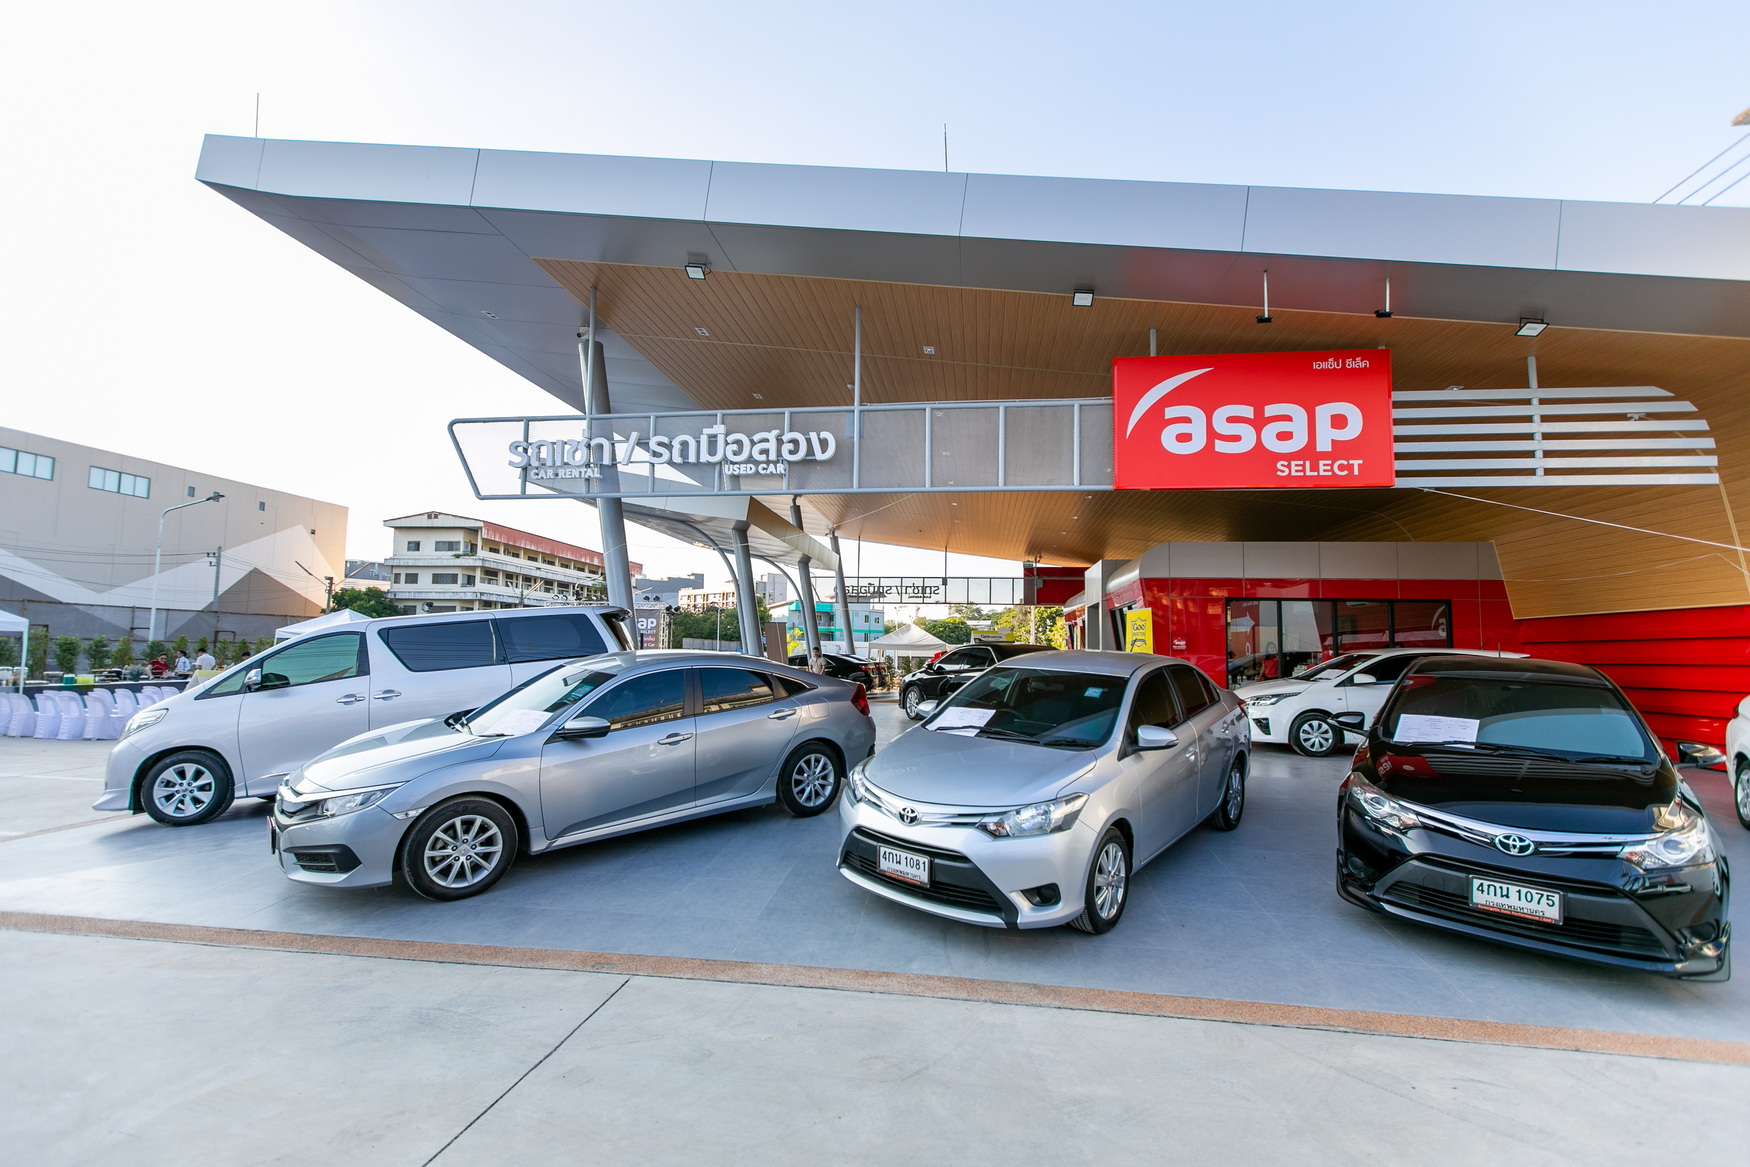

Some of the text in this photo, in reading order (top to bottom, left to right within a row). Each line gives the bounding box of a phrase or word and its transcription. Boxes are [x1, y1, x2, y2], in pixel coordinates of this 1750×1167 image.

[1161, 402, 1363, 455] asap
[508, 428, 612, 469] รถเช่า
[649, 424, 837, 465] รถมือสอง
[530, 467, 603, 480] CAR RENTAL
[724, 462, 786, 475] USED CAR
[1276, 459, 1363, 476] SELECT
[882, 850, 926, 873] 4กน 1081
[1476, 881, 1556, 908] 4กน 1075
